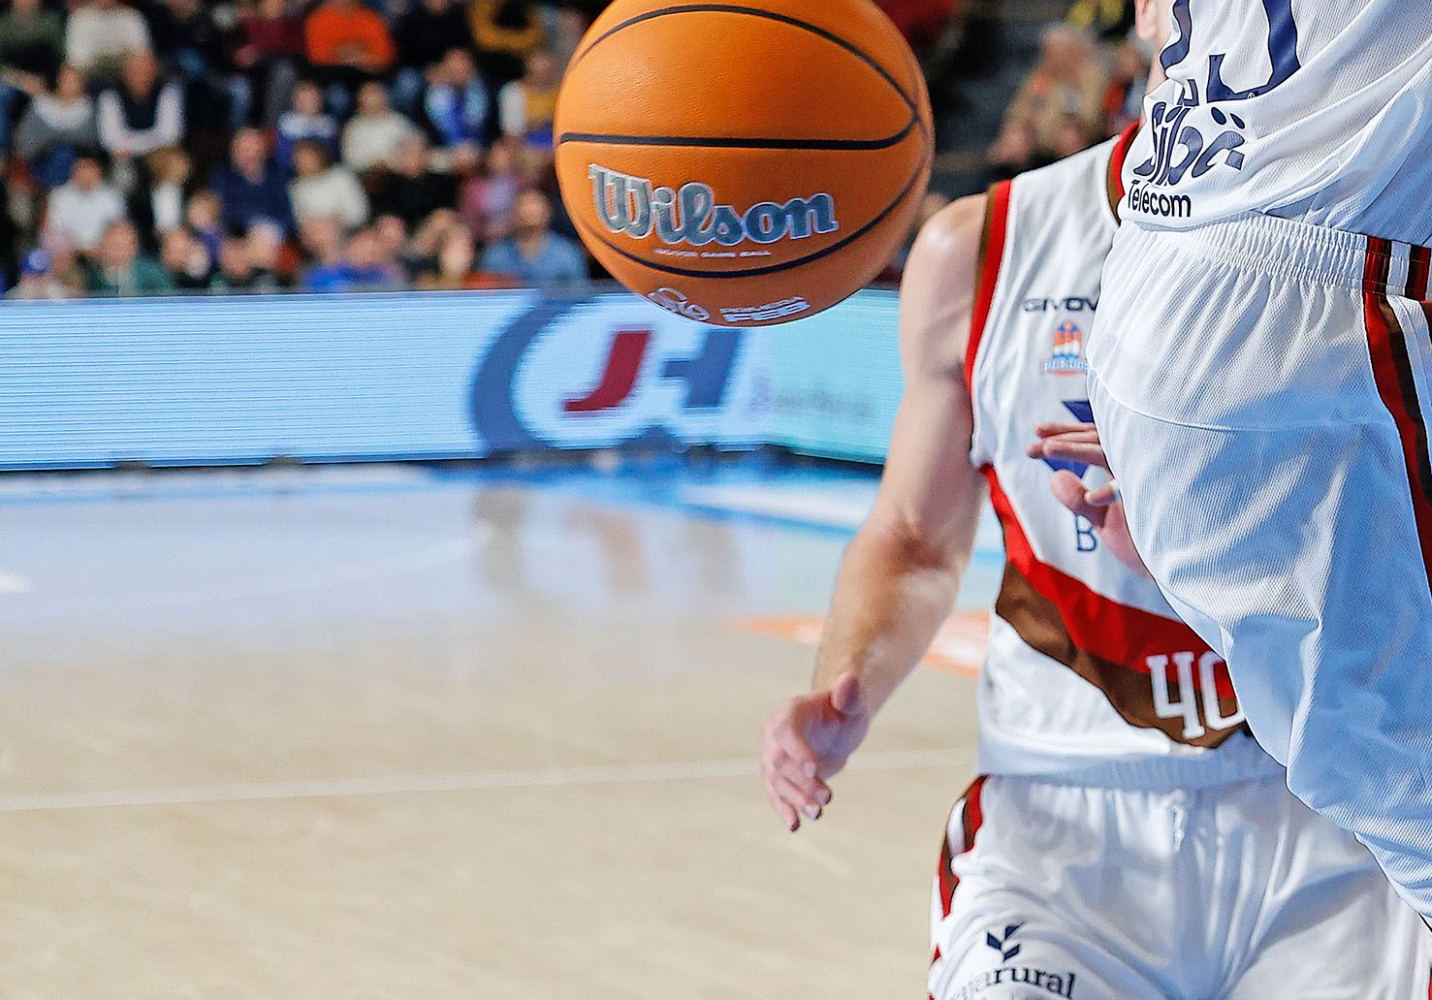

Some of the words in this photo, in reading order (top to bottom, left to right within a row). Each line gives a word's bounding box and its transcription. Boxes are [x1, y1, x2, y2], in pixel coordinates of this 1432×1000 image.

[588, 162, 839, 247] Wilson
[1128, 179, 1192, 218] Telecom
[1145, 650, 1246, 740] 40
